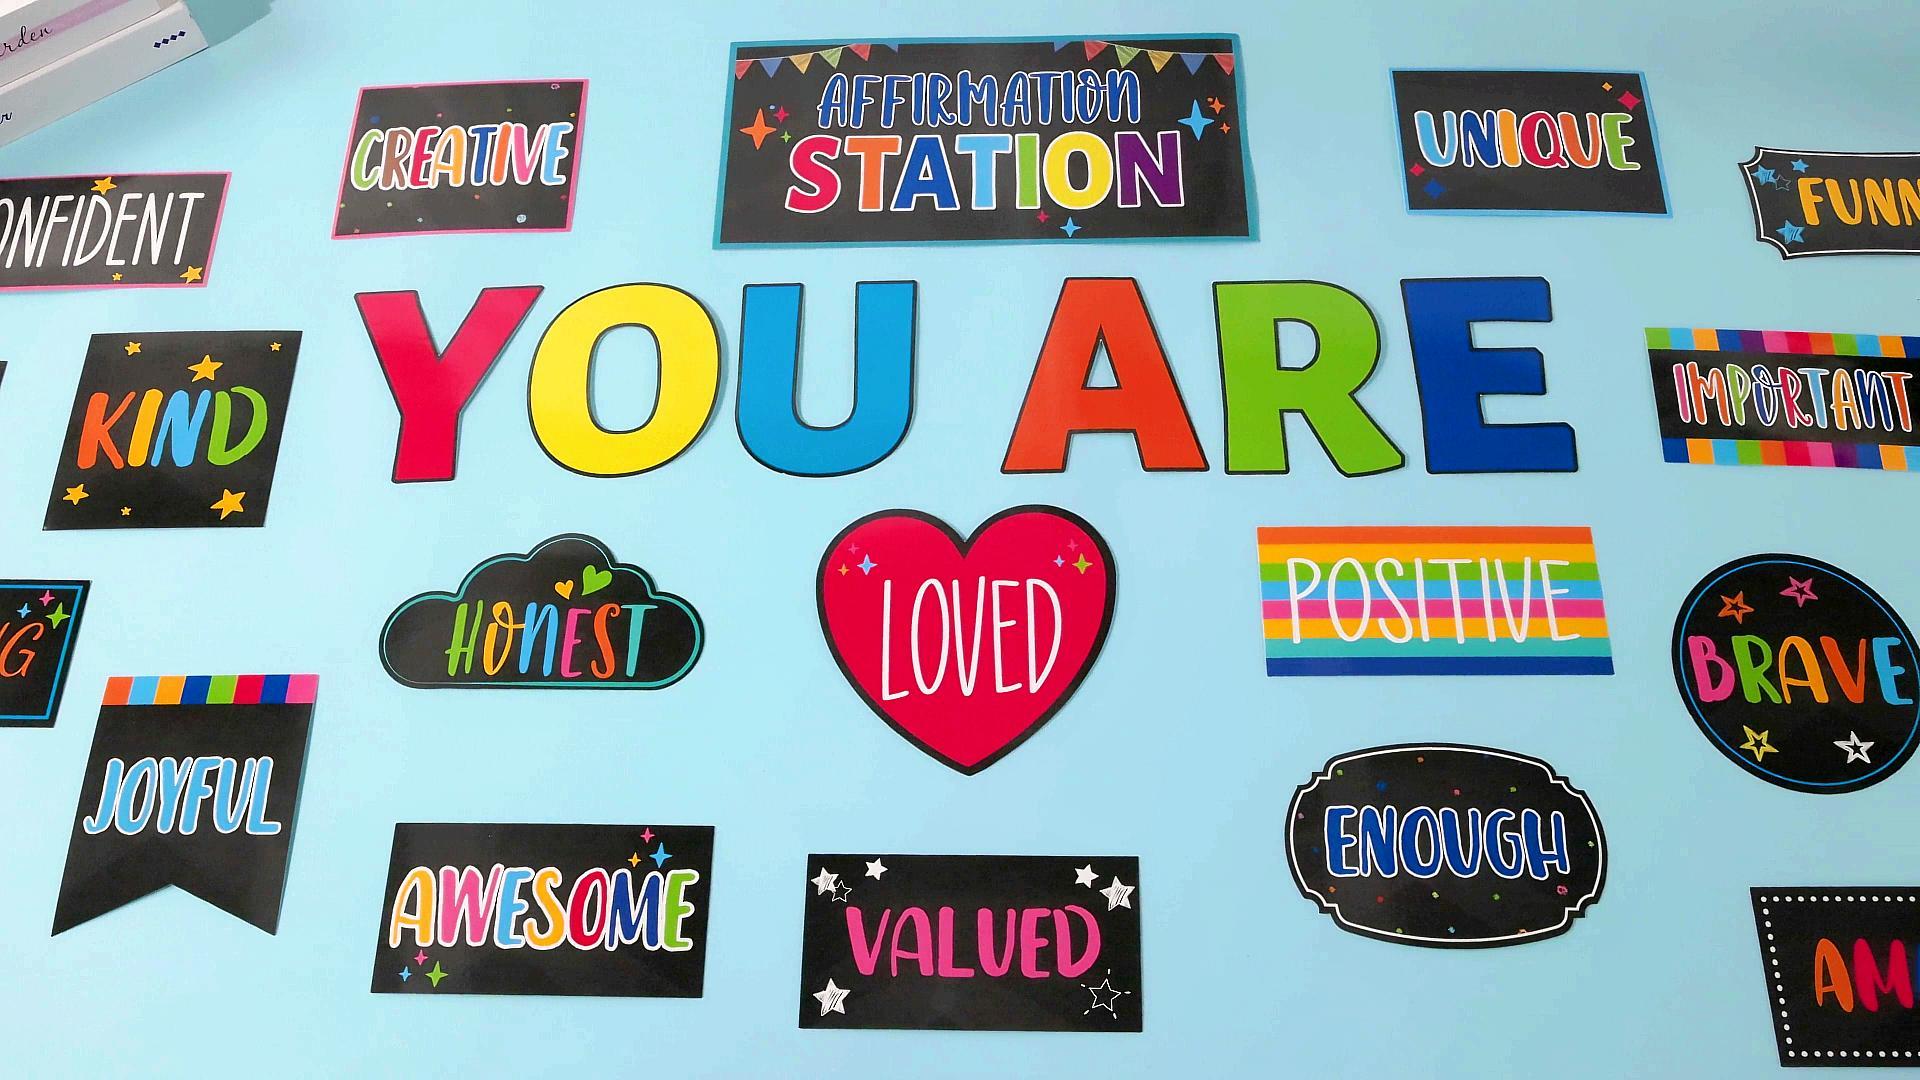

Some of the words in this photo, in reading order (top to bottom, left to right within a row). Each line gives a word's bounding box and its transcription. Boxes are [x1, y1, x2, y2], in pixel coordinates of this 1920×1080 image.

[0, 26, 53, 57] rden
[818, 69, 1141, 128] AFFIRMATION
[351, 121, 574, 190] CREATIVE
[784, 130, 1185, 213] STATION
[1414, 109, 1641, 170] UNIQUE
[354, 280, 918, 484] YOU
[1000, 277, 1578, 478] ARE
[1672, 361, 1914, 432] IMPORTANT
[77, 388, 268, 469] KIND
[882, 575, 1063, 701] LOVED
[1286, 557, 1581, 644] POSITIVE
[445, 600, 658, 679] HONEST
[1687, 634, 1914, 706] BRAVE
[82, 756, 282, 836] JOYFUL
[1324, 805, 1571, 880] ENOUGH
[389, 863, 700, 952] AWESOME
[845, 904, 1102, 979] VALUED
[1814, 938, 1920, 1013] AM
